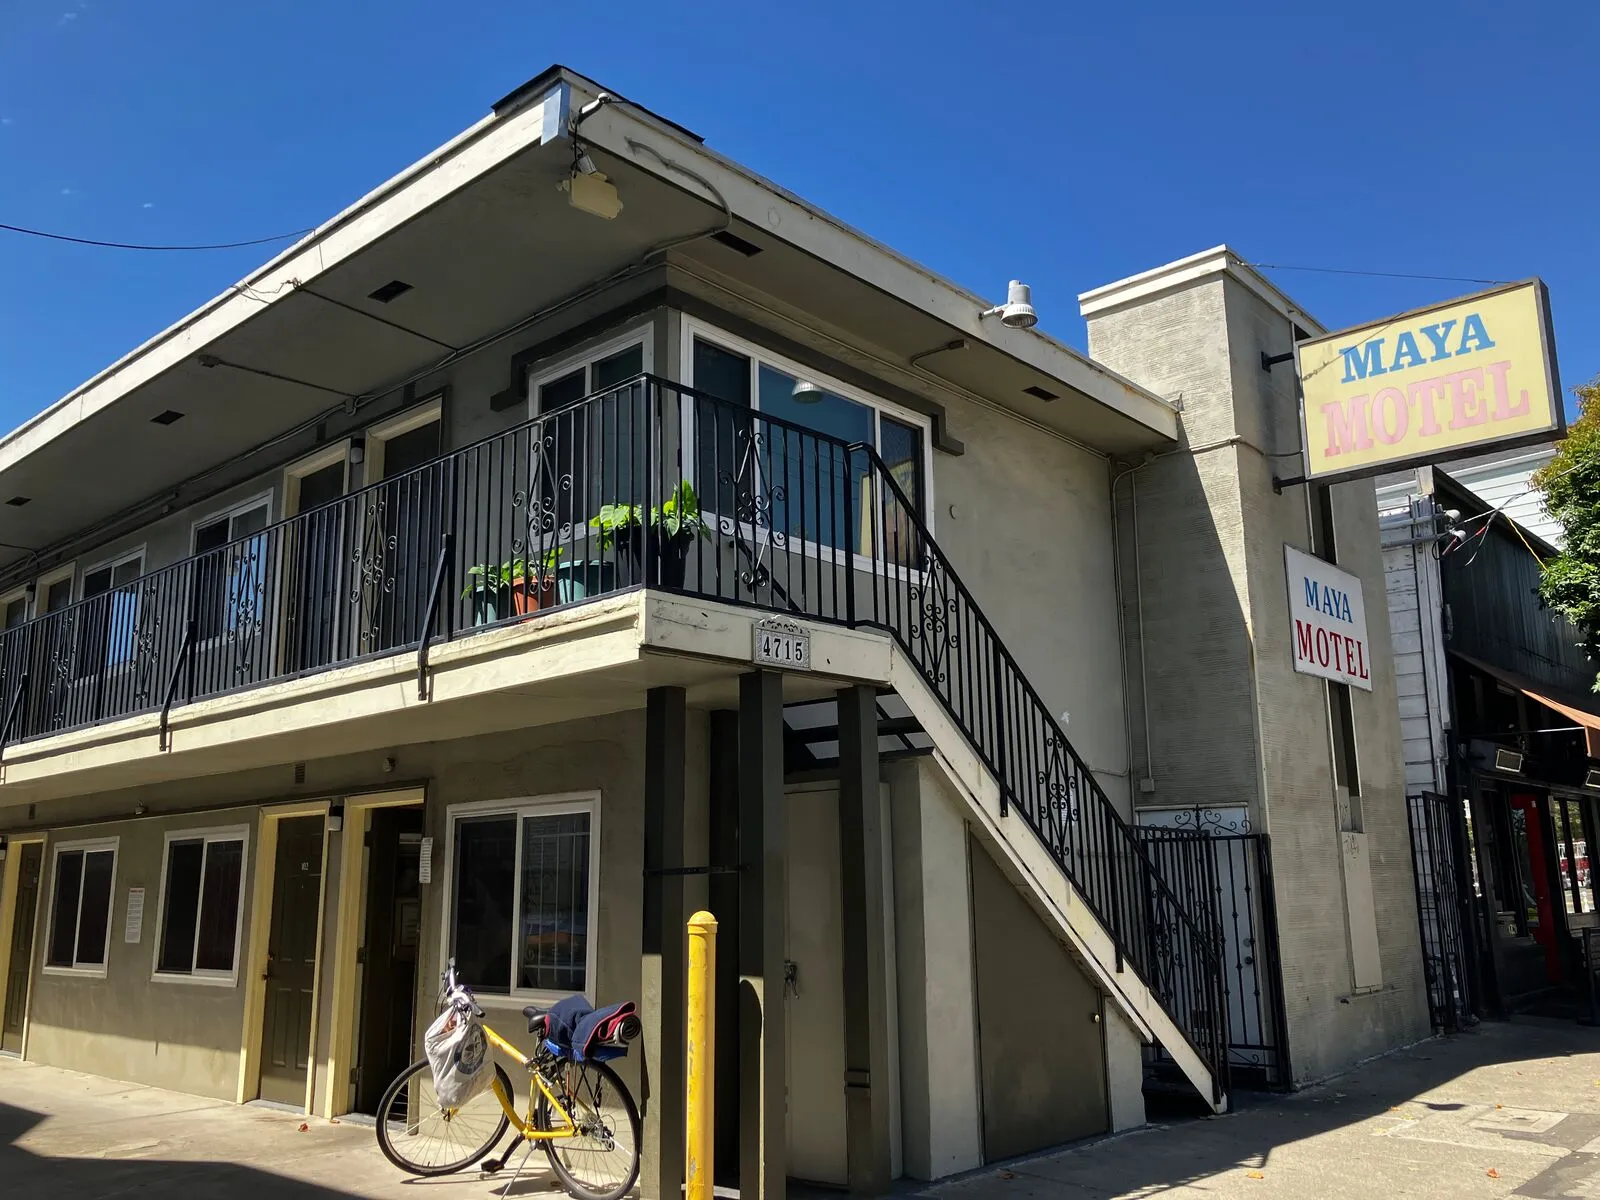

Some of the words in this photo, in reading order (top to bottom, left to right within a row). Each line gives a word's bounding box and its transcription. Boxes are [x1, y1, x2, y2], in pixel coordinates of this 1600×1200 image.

[1338, 313, 1496, 384] MAYA
[1320, 360, 1530, 458] MOTEL
[1303, 576, 1354, 624] MAYA
[763, 636, 803, 661] 4715
[1295, 619, 1369, 680] MOTEL
